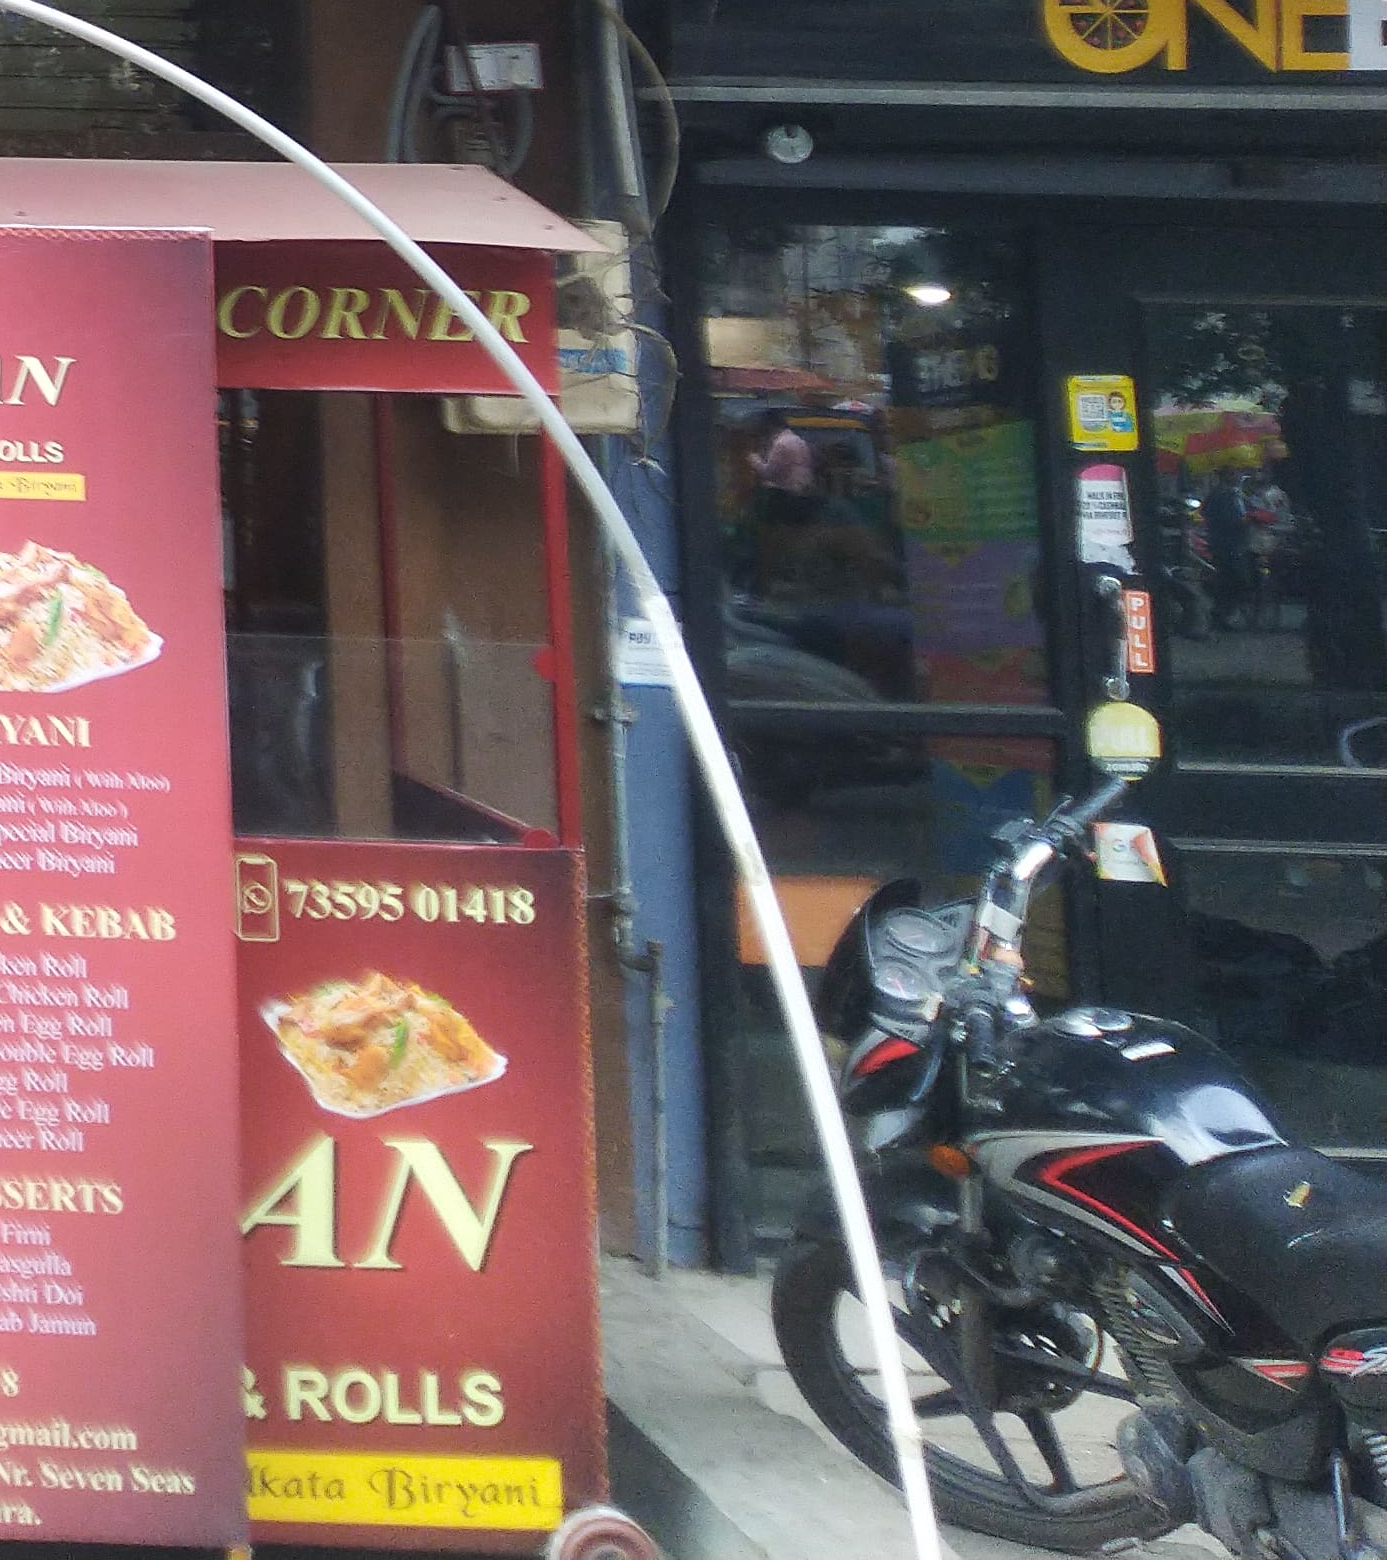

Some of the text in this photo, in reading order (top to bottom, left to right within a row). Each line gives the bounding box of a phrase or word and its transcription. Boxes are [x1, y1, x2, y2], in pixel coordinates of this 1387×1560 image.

[217, 285, 531, 343] CORNER
[59, 820, 139, 850] Biryani
[36, 847, 116, 877] Biryani
[285, 878, 536, 925] 73595 01418
[0, 901, 32, 936] &
[38, 902, 177, 941] KEBAB
[40, 951, 87, 979] Roll
[82, 983, 130, 1010] Roll
[19, 1009, 63, 1040] Egg
[66, 1010, 113, 1038] Roll
[60, 1039, 104, 1071] Egg
[107, 1041, 155, 1069] Roll
[22, 1067, 68, 1093] Roll
[16, 1094, 60, 1126] Egg
[63, 1097, 111, 1124] Roll
[38, 1125, 84, 1152] Roll
[43, 1279, 84, 1306] Doi
[27, 1307, 97, 1336] Jamun
[284, 1367, 506, 1427] ROLLS
[39, 1457, 123, 1491] Seven
[130, 1463, 196, 1495] Seas
[369, 1466, 541, 1518] Biryani
